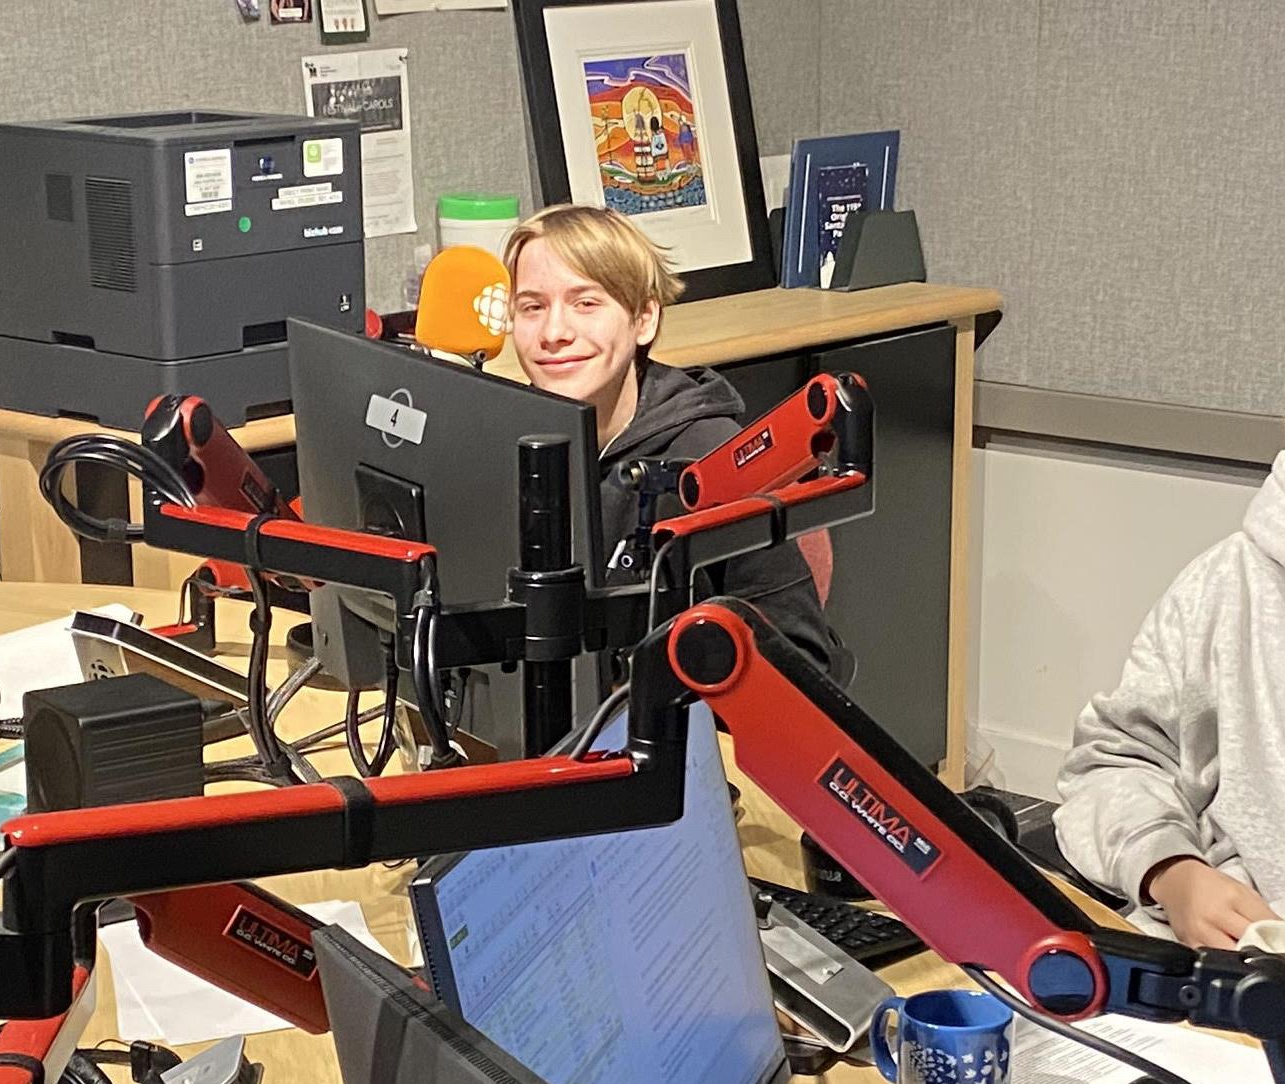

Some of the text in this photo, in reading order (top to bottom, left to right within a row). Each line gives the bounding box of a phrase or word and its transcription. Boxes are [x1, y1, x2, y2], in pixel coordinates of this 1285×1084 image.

[362, 97, 394, 112] CAROLS
[390, 408, 400, 428] 4
[833, 767, 911, 847] ULTIMA
[851, 800, 887, 836] WHITE
[238, 915, 300, 960] ULTIMA
